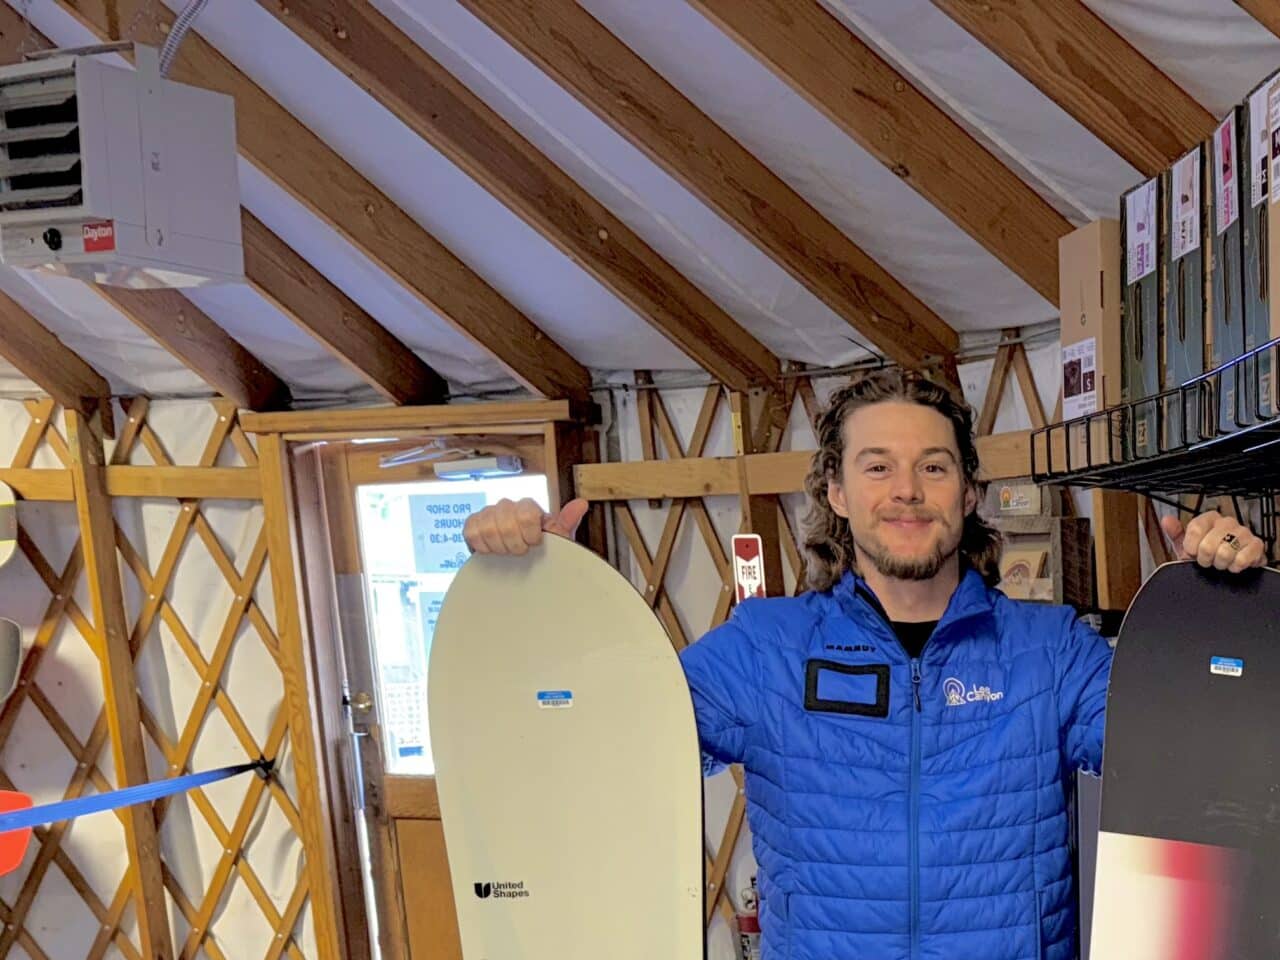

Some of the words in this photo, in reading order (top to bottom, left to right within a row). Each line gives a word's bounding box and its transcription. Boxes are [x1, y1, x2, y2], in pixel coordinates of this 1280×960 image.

[83, 226, 113, 241] Dayton
[741, 565, 758, 581] FIRE
[826, 644, 877, 653] MAMMUT
[972, 683, 991, 693] Lee
[966, 689, 1004, 702] Canyon
[492, 881, 524, 890] United
[493, 889, 530, 899] Shapes
